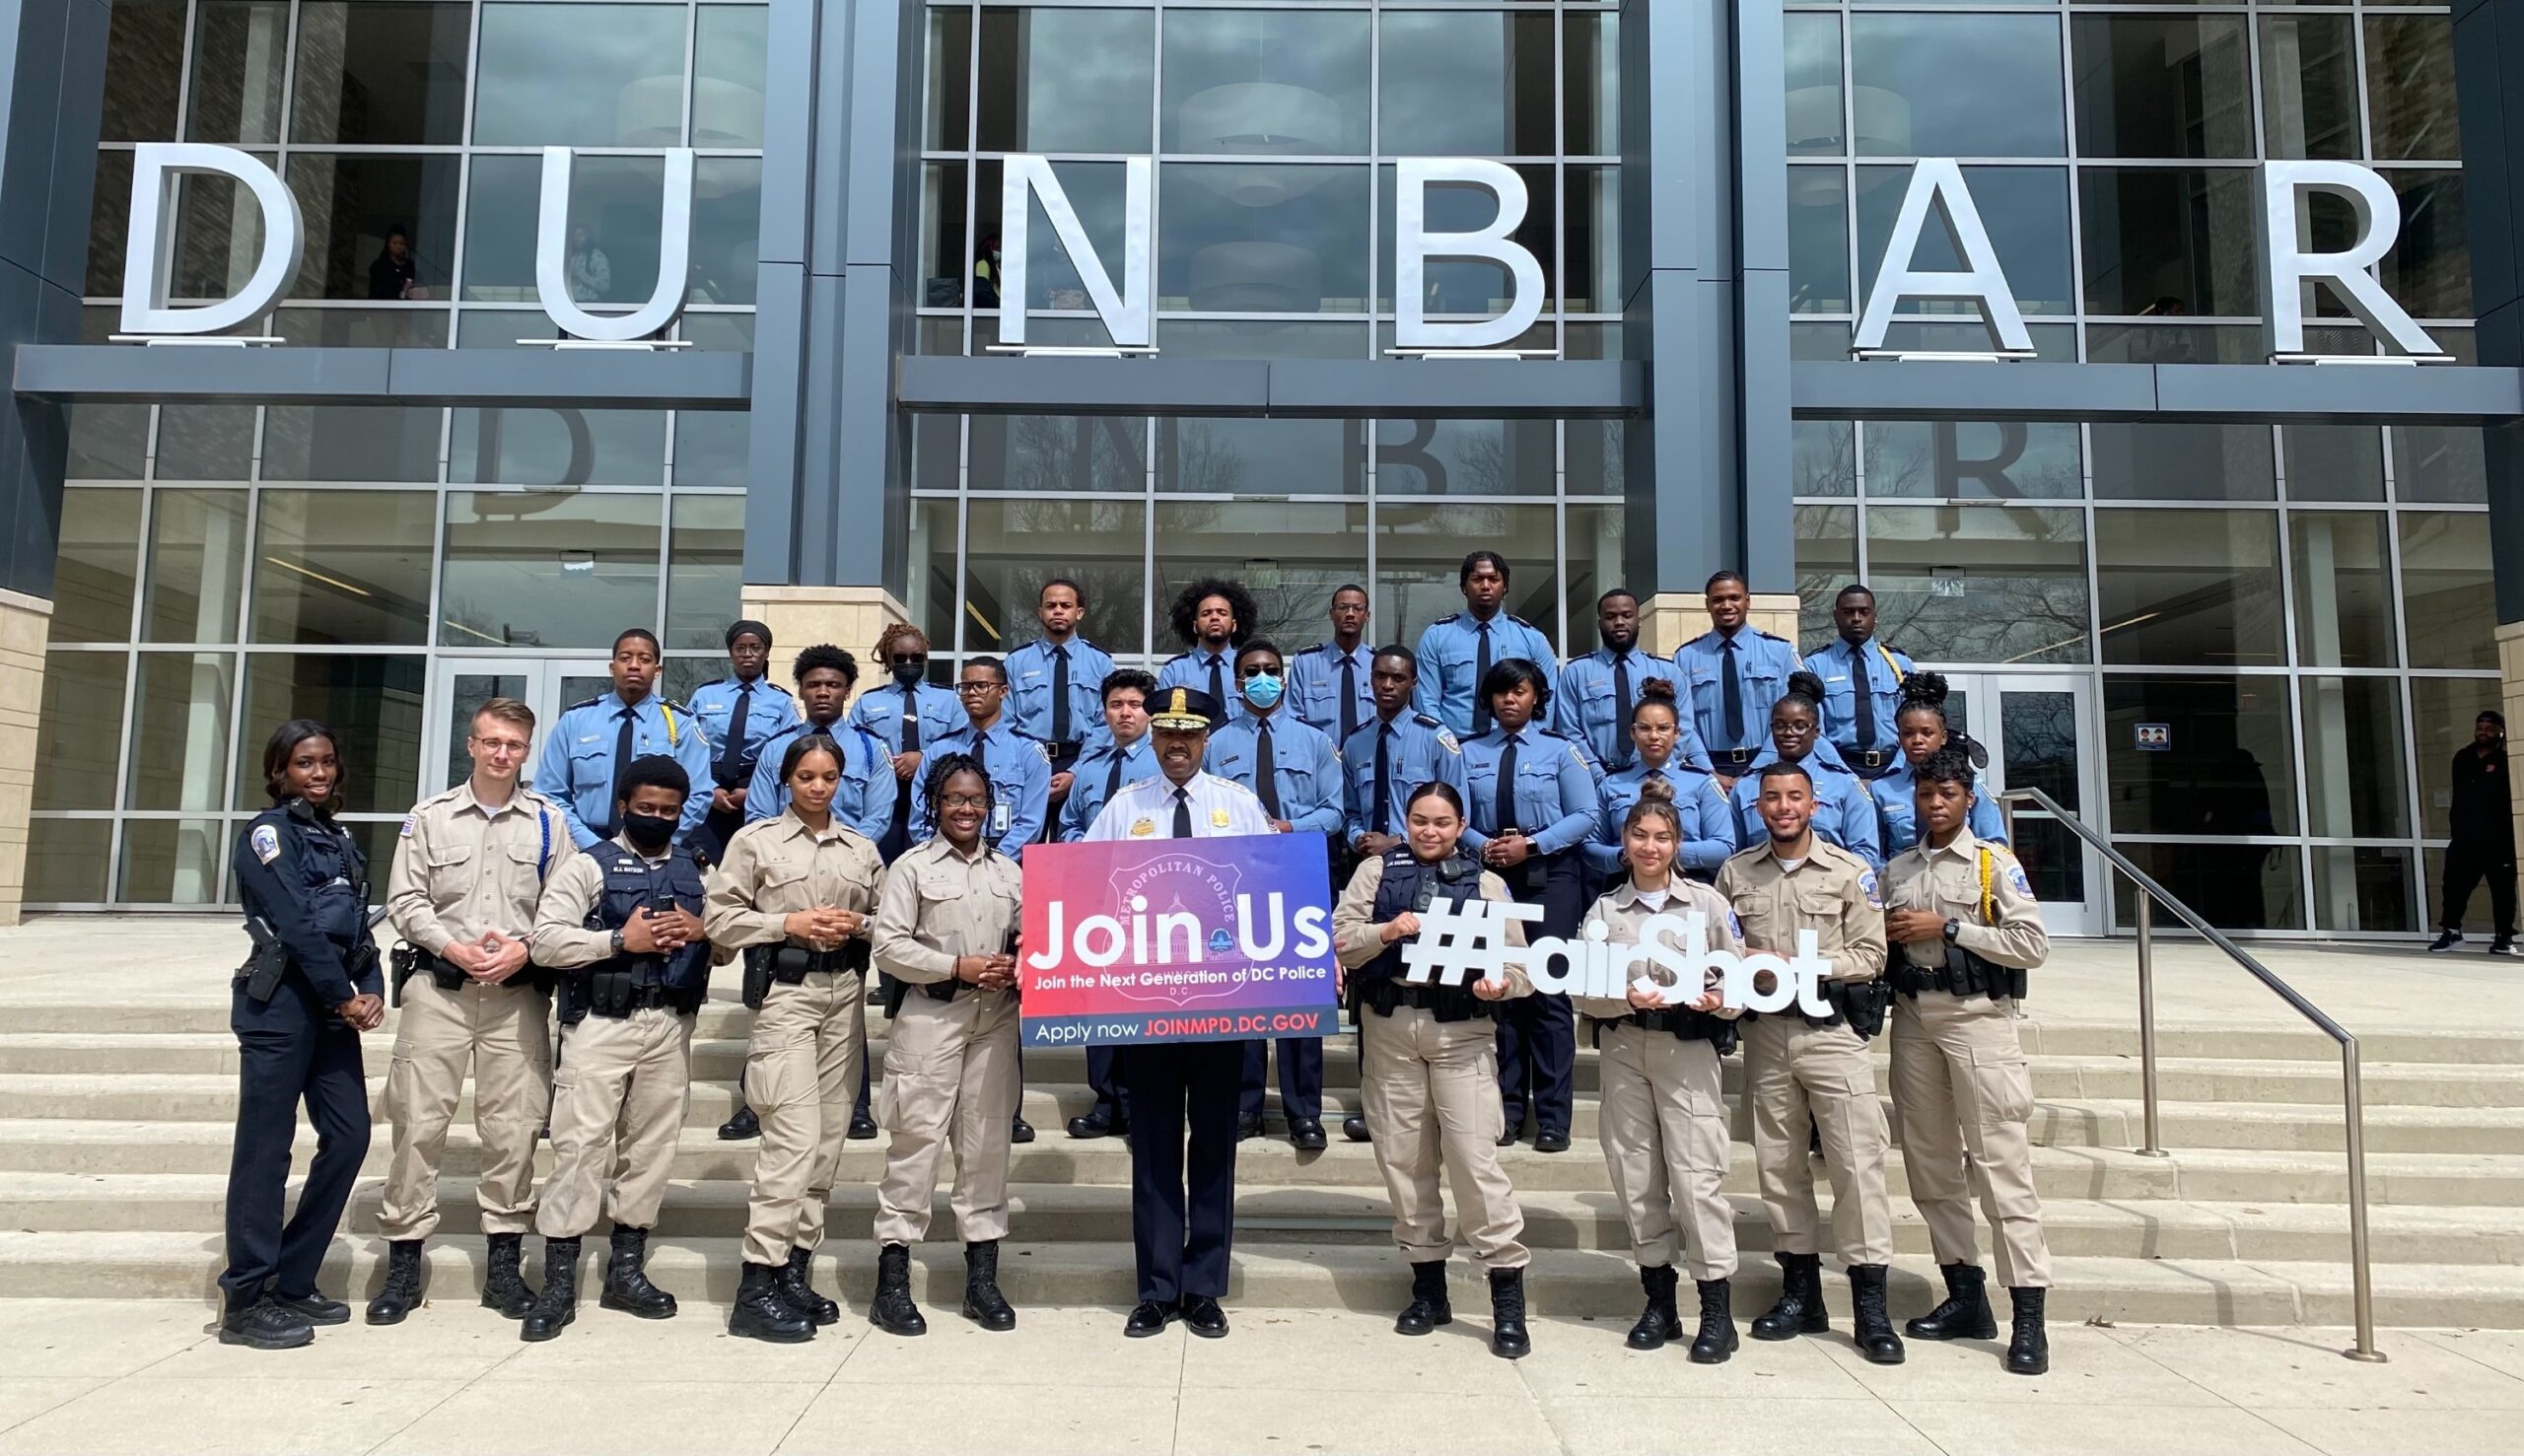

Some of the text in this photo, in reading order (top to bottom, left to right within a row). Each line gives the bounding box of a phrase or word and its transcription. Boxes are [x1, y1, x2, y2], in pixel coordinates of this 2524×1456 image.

[119, 142, 2445, 354] DUNBAR
[1119, 861, 1235, 927] METROPOLITAN POLICE
[1026, 892, 1331, 970] Join Us
[1401, 896, 1835, 1018] #FairShot
[1034, 975, 1067, 991] Join
[1070, 972, 1095, 988] the
[1099, 972, 1137, 987] Next
[1140, 969, 1228, 986] Generation
[1231, 968, 1248, 983] of
[1251, 967, 1275, 982] DC
[1279, 964, 1327, 981] Police
[1169, 986, 1193, 997] D.C.
[1035, 1012, 1319, 1044] Apply now JOINMPD.DC.GOV
